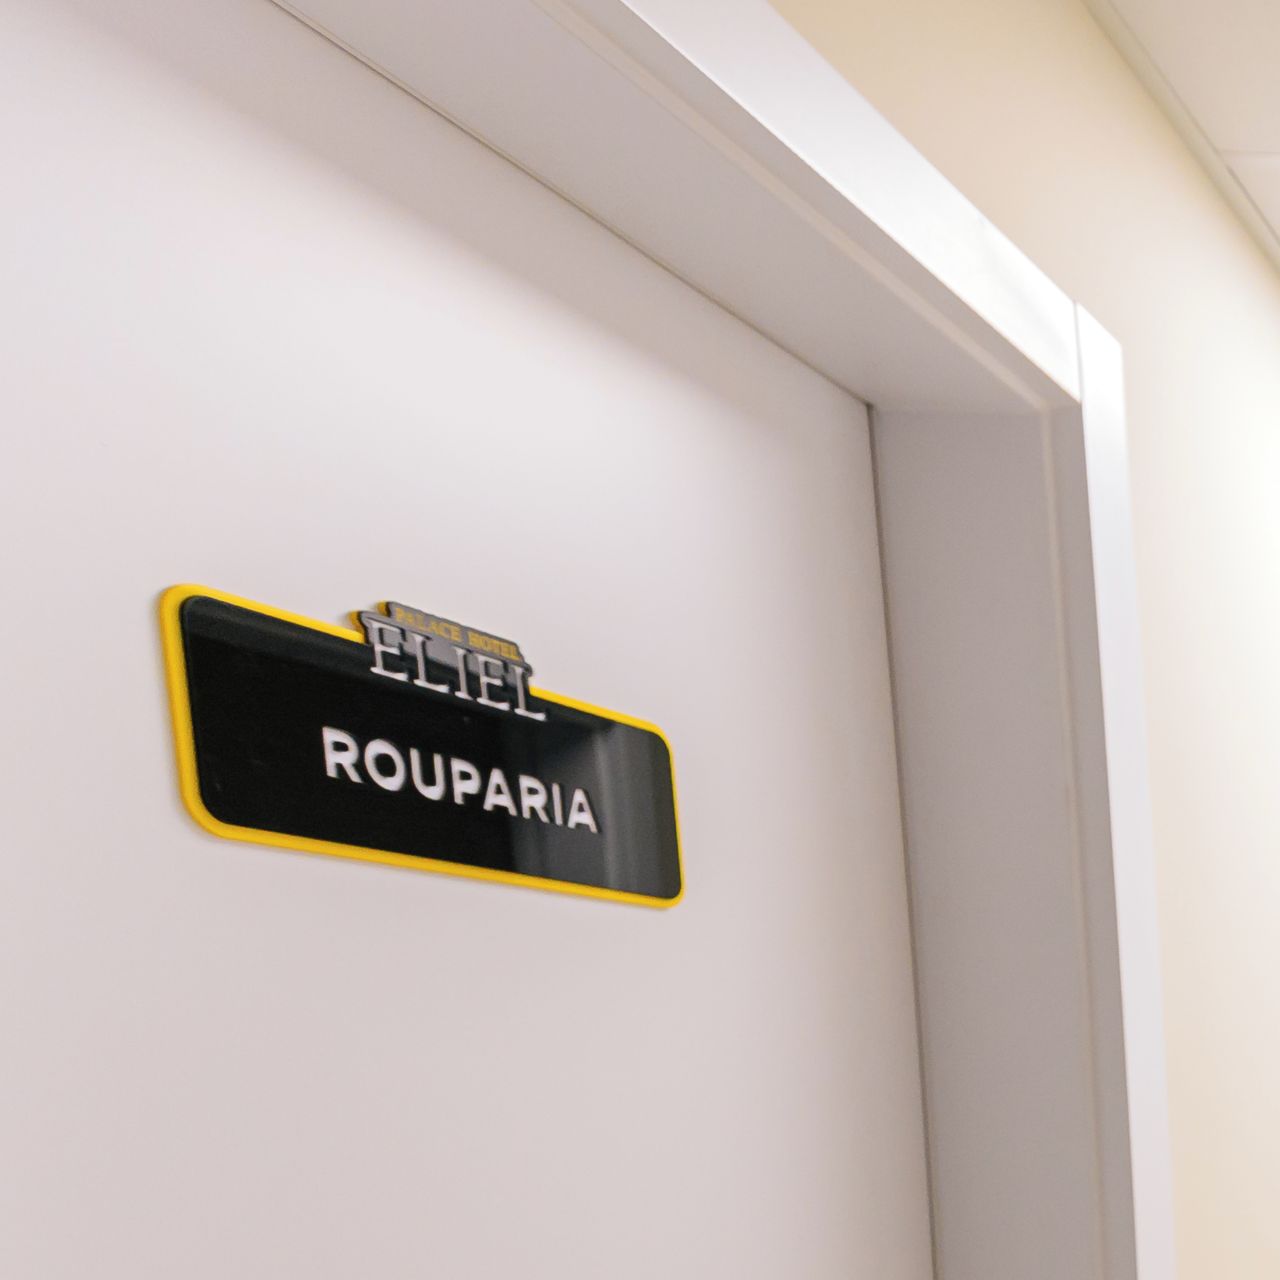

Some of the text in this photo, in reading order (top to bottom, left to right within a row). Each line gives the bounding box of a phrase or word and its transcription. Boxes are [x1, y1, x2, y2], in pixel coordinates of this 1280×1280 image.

[366, 617, 547, 722] ELIEL
[396, 607, 522, 662] PALACE HOTEL
[322, 726, 599, 832] ROUPARIA
